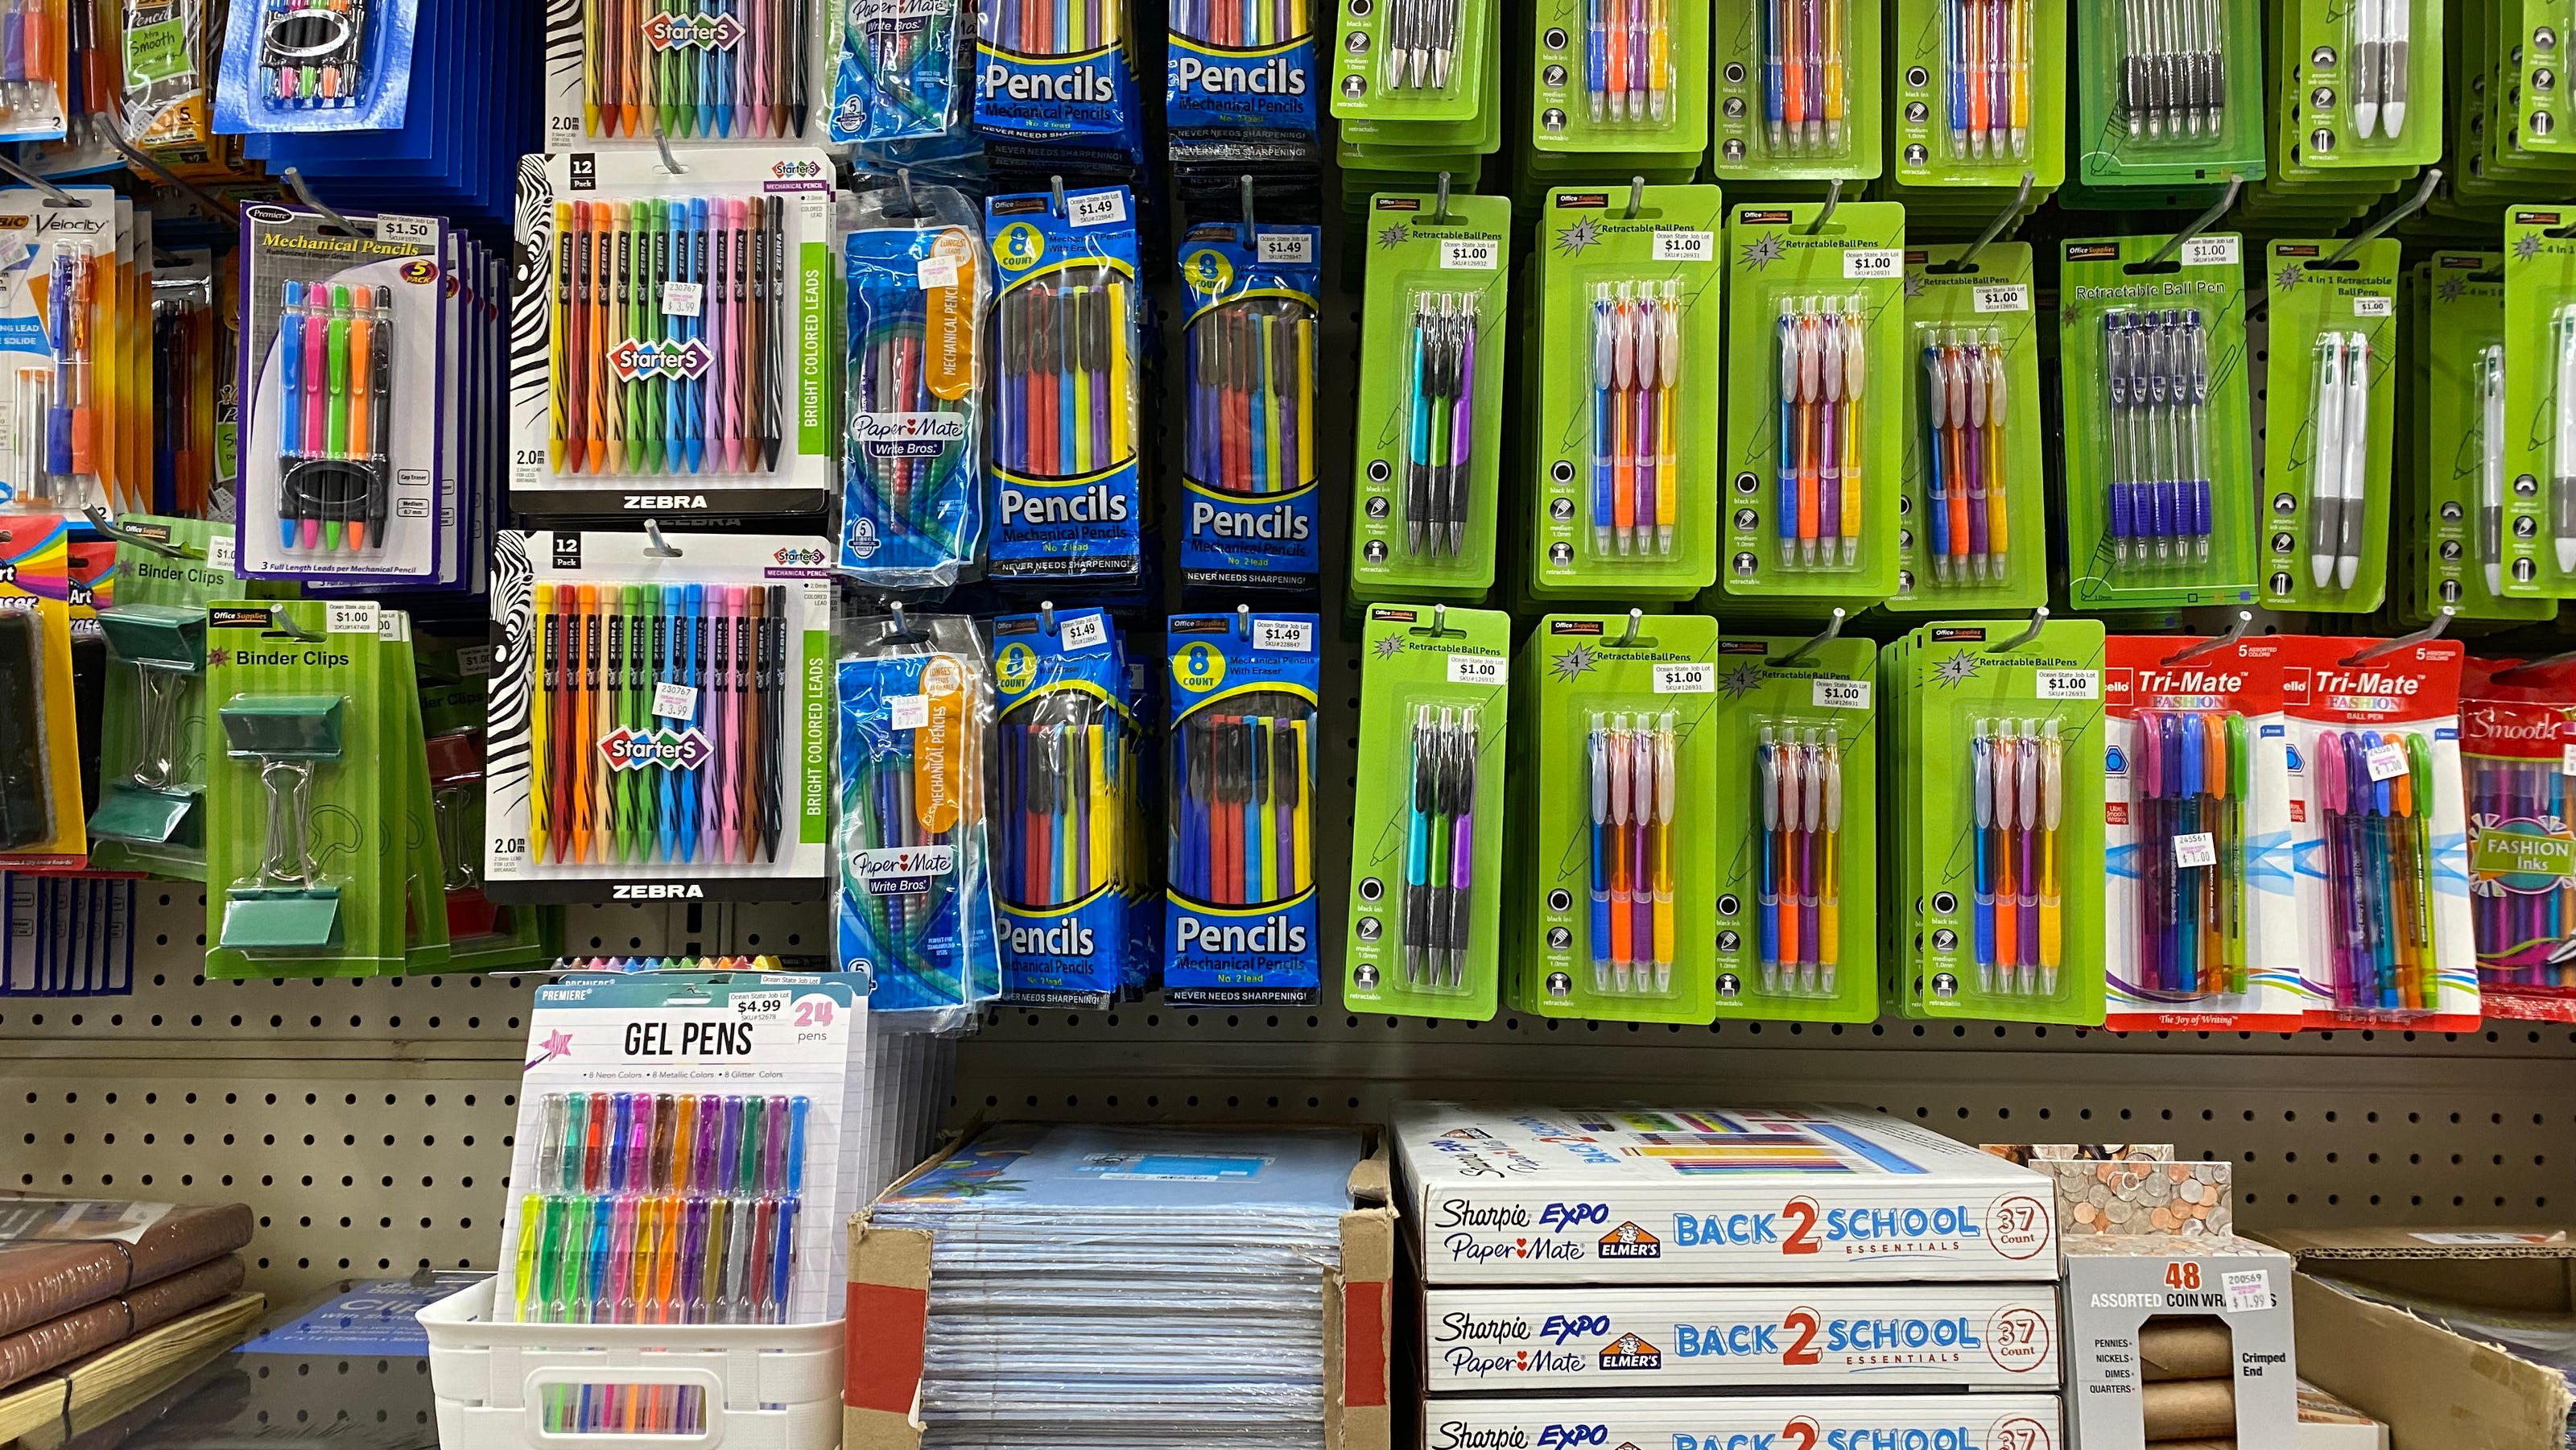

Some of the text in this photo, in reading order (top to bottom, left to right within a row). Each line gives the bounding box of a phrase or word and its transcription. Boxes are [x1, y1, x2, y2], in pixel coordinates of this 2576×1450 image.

[1179, 58, 1306, 94] Pencils
[985, 65, 1113, 101] Pencils
[572, 160, 592, 176] 12
[574, 180, 592, 188] Pack
[766, 182, 806, 190] MECHANICAL
[254, 209, 288, 220] Premiere
[1080, 201, 1113, 216] $1.49
[35, 212, 105, 234] Velocity
[386, 223, 428, 236] $1.50
[1412, 230, 1502, 242] Retractable Ball Pens
[263, 233, 358, 253] Mechanical
[357, 239, 419, 258] Pencils
[1269, 242, 1301, 253] $1.49
[1666, 240, 1701, 251] $1.00
[2194, 246, 2225, 256] $1.00
[1453, 248, 1487, 259] $1.00
[411, 262, 426, 277] 5
[1855, 258, 1890, 270] $1.00
[406, 275, 431, 285] PACK
[670, 284, 696, 293] 230767
[2076, 281, 2225, 300] Retractable Ball Pen
[676, 302, 695, 312] 3.99
[805, 270, 819, 428] BRIGHT COLORED LEADS
[852, 416, 960, 441] Paper Mate
[876, 443, 935, 456] Write Bros.
[624, 496, 707, 509] ZEBRA
[1001, 485, 1127, 524] Pencils
[1193, 502, 1308, 539] Pencils
[556, 539, 576, 552] 12
[262, 561, 268, 570] 3
[285, 564, 312, 572] Length
[313, 564, 335, 572] Leads
[336, 565, 349, 574] per
[350, 565, 393, 574] Mechanical
[394, 566, 416, 574] Pencil
[557, 559, 576, 567] Pack
[138, 564, 224, 586] Binder Clips
[1188, 573, 1216, 581] NEVER
[1249, 576, 1305, 585] SHARPENING!
[70, 590, 91, 603] Art
[336, 612, 369, 622] $1.00
[1265, 630, 1300, 641] $1.49
[1410, 642, 1501, 655] Retractable Ball Pens
[236, 651, 349, 668] Binder Clips
[1570, 655, 1579, 667] 4
[1597, 652, 1690, 661] Retractable Ball Pens
[1980, 658, 2077, 667] Retractable Ball Pens
[1460, 664, 1495, 675] $1.00
[1183, 678, 1213, 687] COUNT
[1666, 671, 1702, 684] $1.00
[2049, 677, 2086, 690] $1.00
[2139, 671, 2242, 692] Tri-Mate
[2317, 671, 2418, 695] Tri-Mate
[662, 687, 691, 696] 230767
[2152, 696, 2226, 708] FASHION
[2329, 696, 2401, 709] FASHION
[2471, 712, 2557, 739] Smooth
[807, 658, 824, 816] BRIGHT COLORED LEADS
[2179, 835, 2207, 844] 245561
[2488, 839, 2568, 856] FASHION
[852, 853, 947, 877] Paper Mate
[2517, 856, 2548, 871] Inks
[613, 885, 703, 899] ZEBRA
[870, 880, 924, 893] Write Bros.
[1177, 916, 1307, 953] Pencils
[543, 990, 587, 1001] PREMIERE
[1174, 992, 1307, 1001] NEVER NEEDS SHARPENING!
[738, 999, 781, 1014] $4.99
[794, 1002, 833, 1027] 24
[2160, 1015, 2232, 1027] The Joy of Writing
[625, 1022, 753, 1055] GEL PENS
[799, 1031, 827, 1043] pens
[1435, 1199, 1530, 1229] Sharpie
[1539, 1203, 1608, 1234] EXPO
[1997, 1205, 2035, 1233] 37
[1673, 1195, 1980, 1255] BACK 2 SCHOOL
[2000, 1232, 2035, 1246] Count
[1445, 1235, 1582, 1265] Paper Mate
[1602, 1243, 1660, 1258] ELMER'S
[1846, 1241, 1961, 1254] ESSENTIALS
[2165, 1262, 2201, 1291] 48
[2228, 1274, 2262, 1285] 200569
[2091, 1294, 2162, 1308] ASSORTED
[2166, 1294, 2199, 1308] COIN
[2244, 1295, 2265, 1307] 1.99
[1435, 1312, 1531, 1342] Sharpie
[1539, 1316, 1611, 1339] EXPO
[1997, 1317, 2035, 1345] 37
[1674, 1306, 1980, 1366] BACK 2 SCHOOL
[2095, 1340, 2128, 1348] PENNIES
[2000, 1345, 2035, 1358] Count
[1446, 1347, 1583, 1377] Paper Mate
[1602, 1355, 1660, 1369] ELMER'S
[1846, 1353, 1961, 1365] ESSENTIALS
[2096, 1354, 2129, 1363] NICKELS
[2242, 1352, 2286, 1366] Crimped
[2105, 1369, 2131, 1378] DIMES
[2243, 1365, 2263, 1377] End
[2090, 1385, 2132, 1394] QUARTERS
